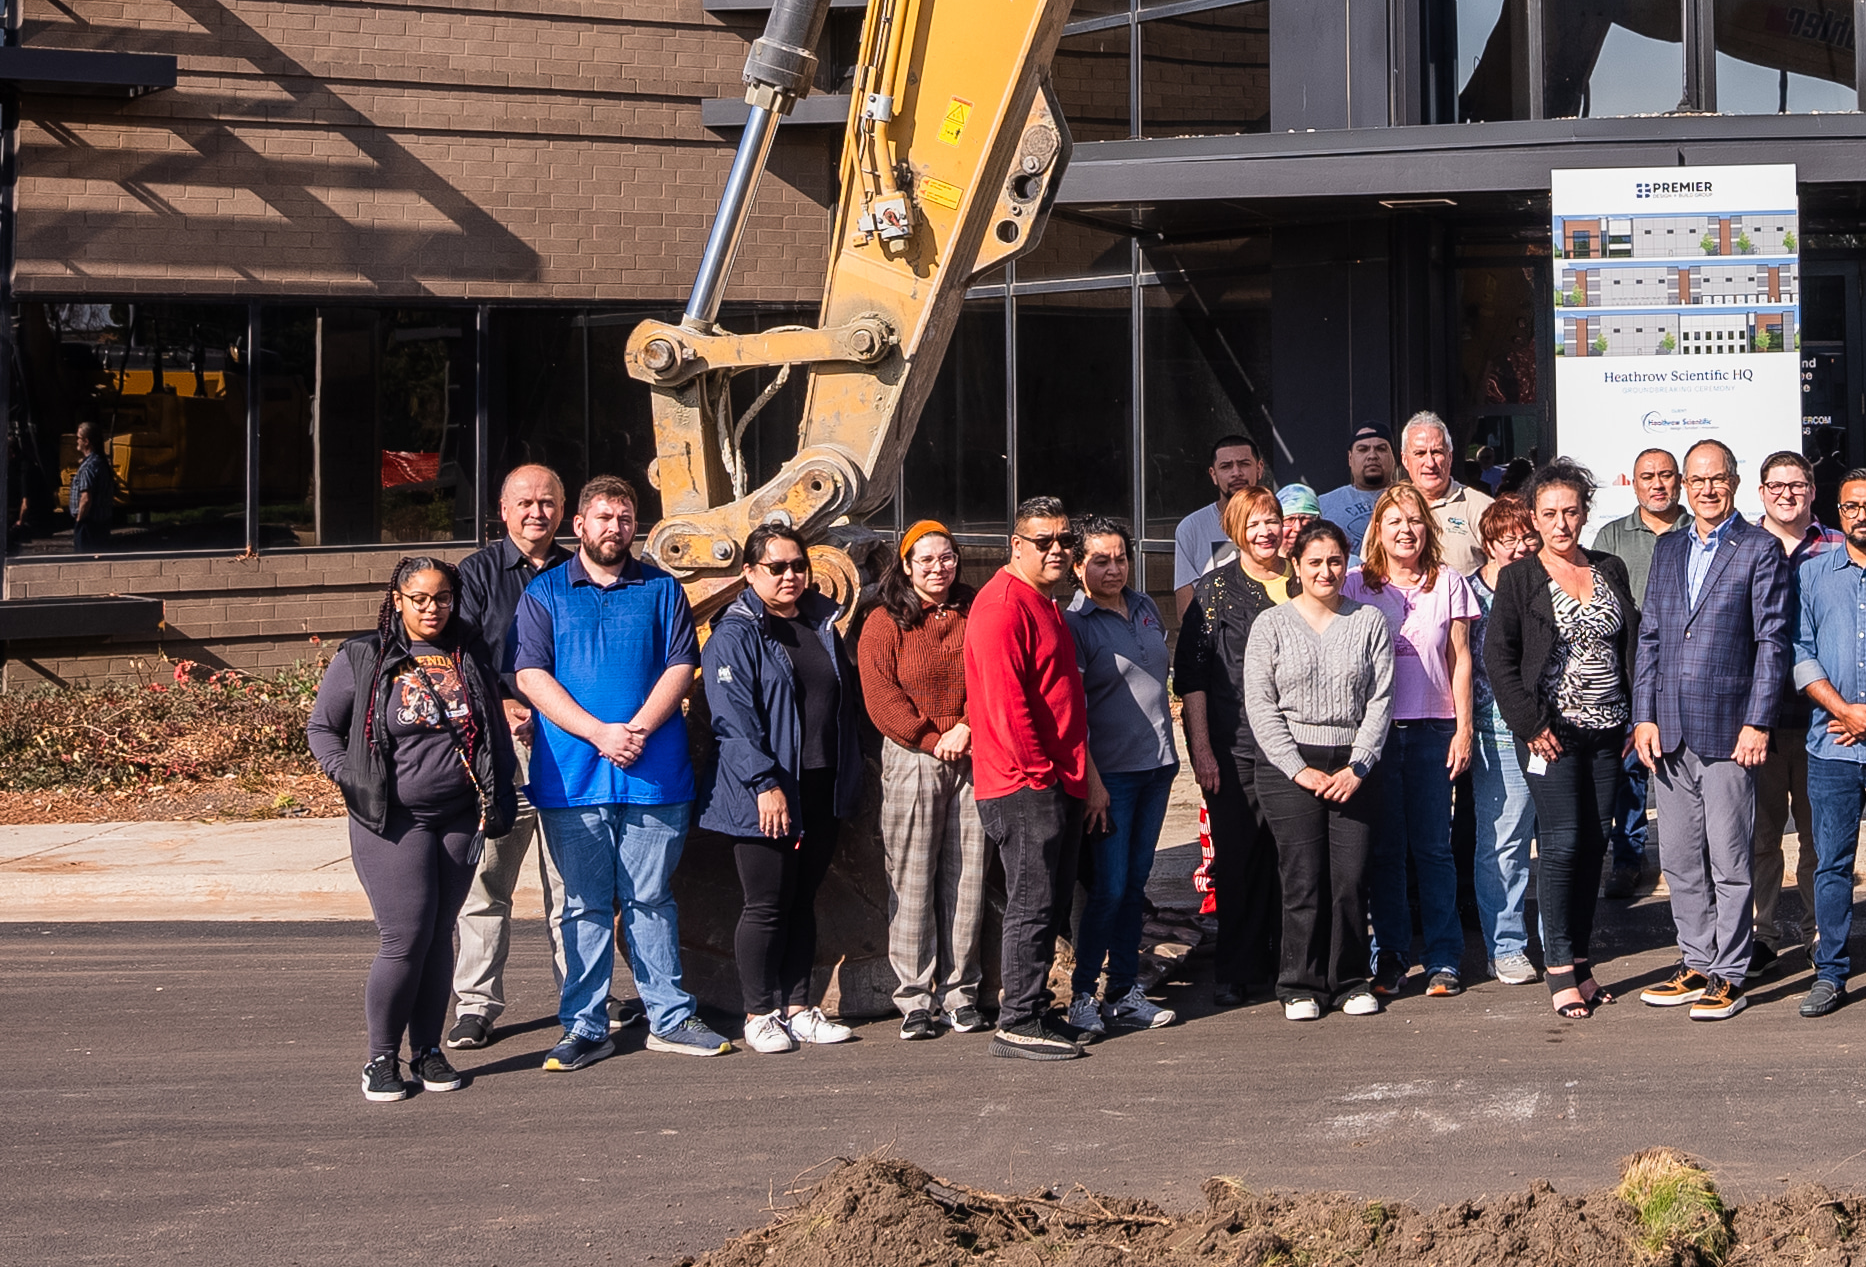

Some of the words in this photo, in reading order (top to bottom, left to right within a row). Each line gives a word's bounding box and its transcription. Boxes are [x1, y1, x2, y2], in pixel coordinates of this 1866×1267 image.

[1653, 182, 1712, 193] PREMIER
[1604, 371, 1667, 383] Heathrow
[1671, 369, 1729, 382] Scientific
[1733, 369, 1753, 382] HQ
[1622, 385, 1692, 394] GROUNDBREAKING
[1802, 416, 1831, 424] ERCOM
